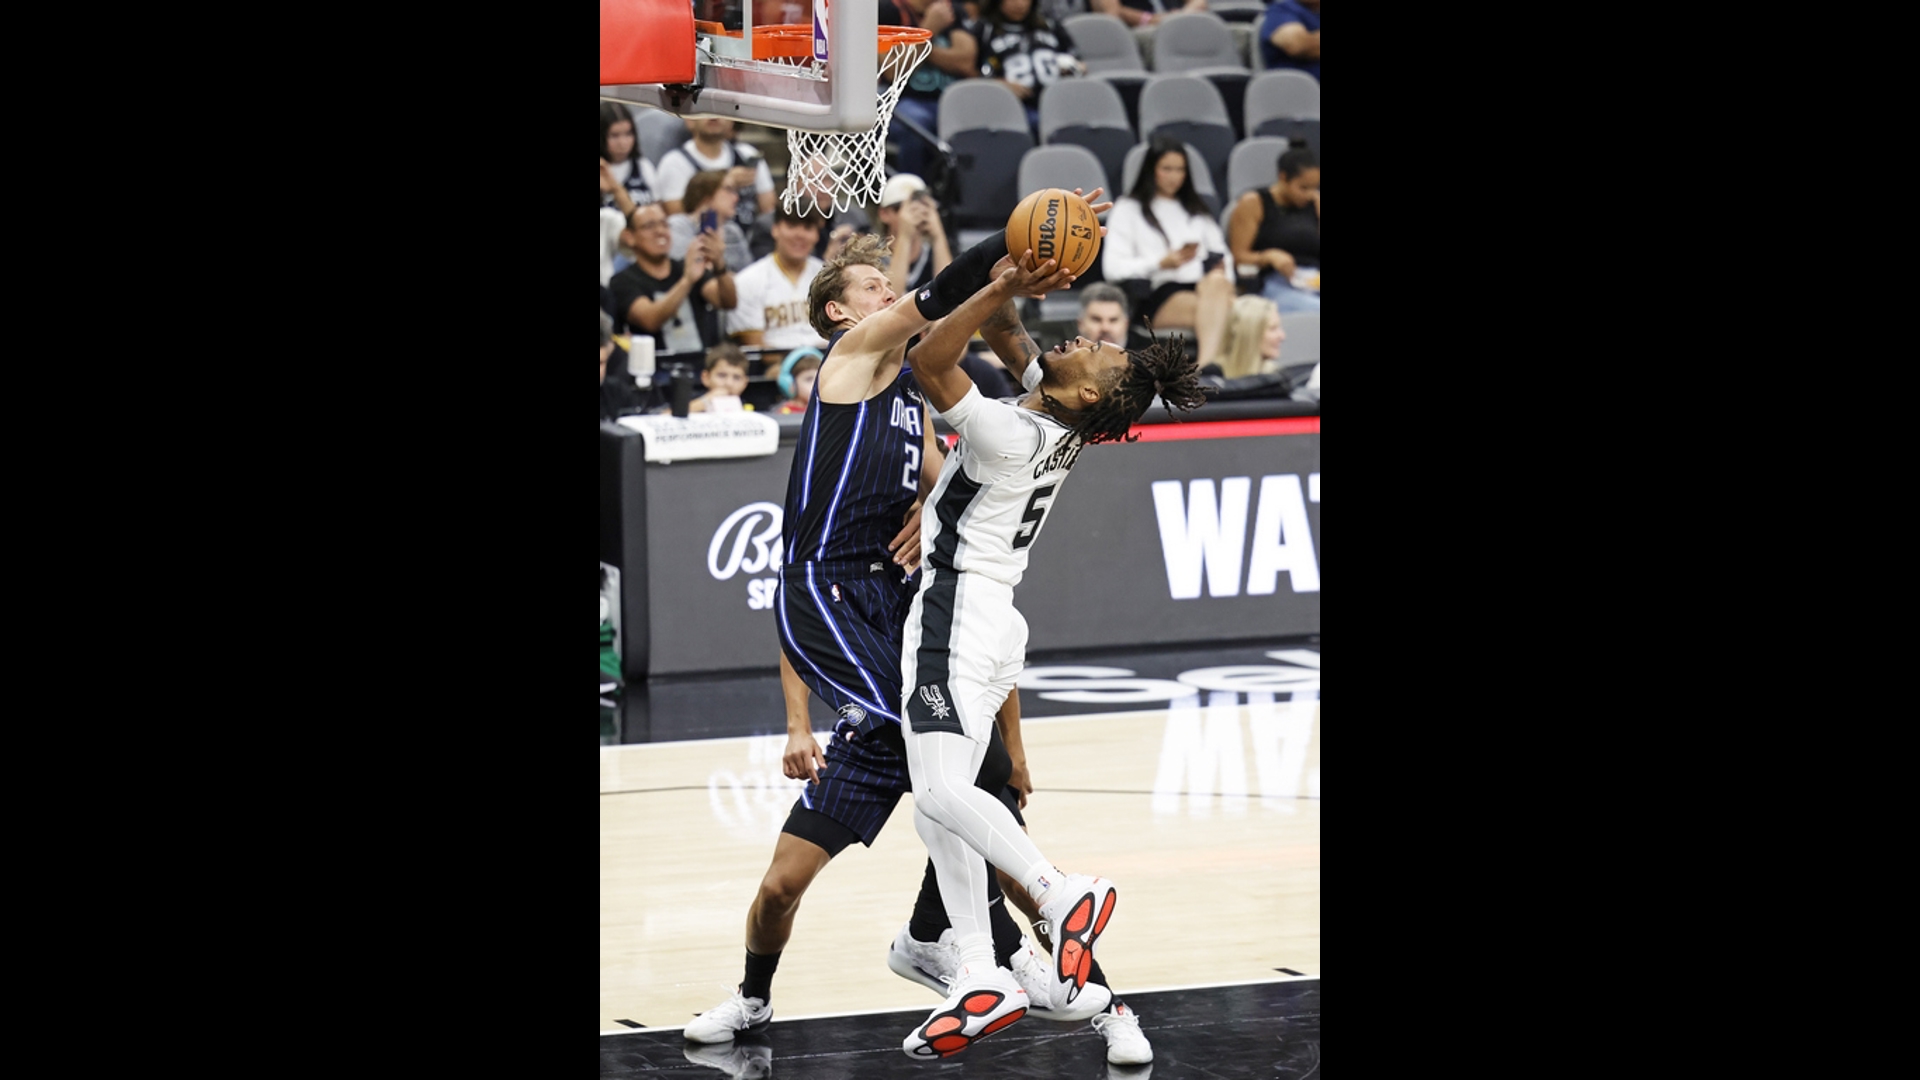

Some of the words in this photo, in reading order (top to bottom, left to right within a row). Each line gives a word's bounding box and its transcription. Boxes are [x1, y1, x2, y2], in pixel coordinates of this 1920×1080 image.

[1038, 198, 1060, 259] Wilson
[902, 442, 920, 492] 2
[1012, 484, 1056, 550] 5
[1151, 473, 1320, 600] WA
